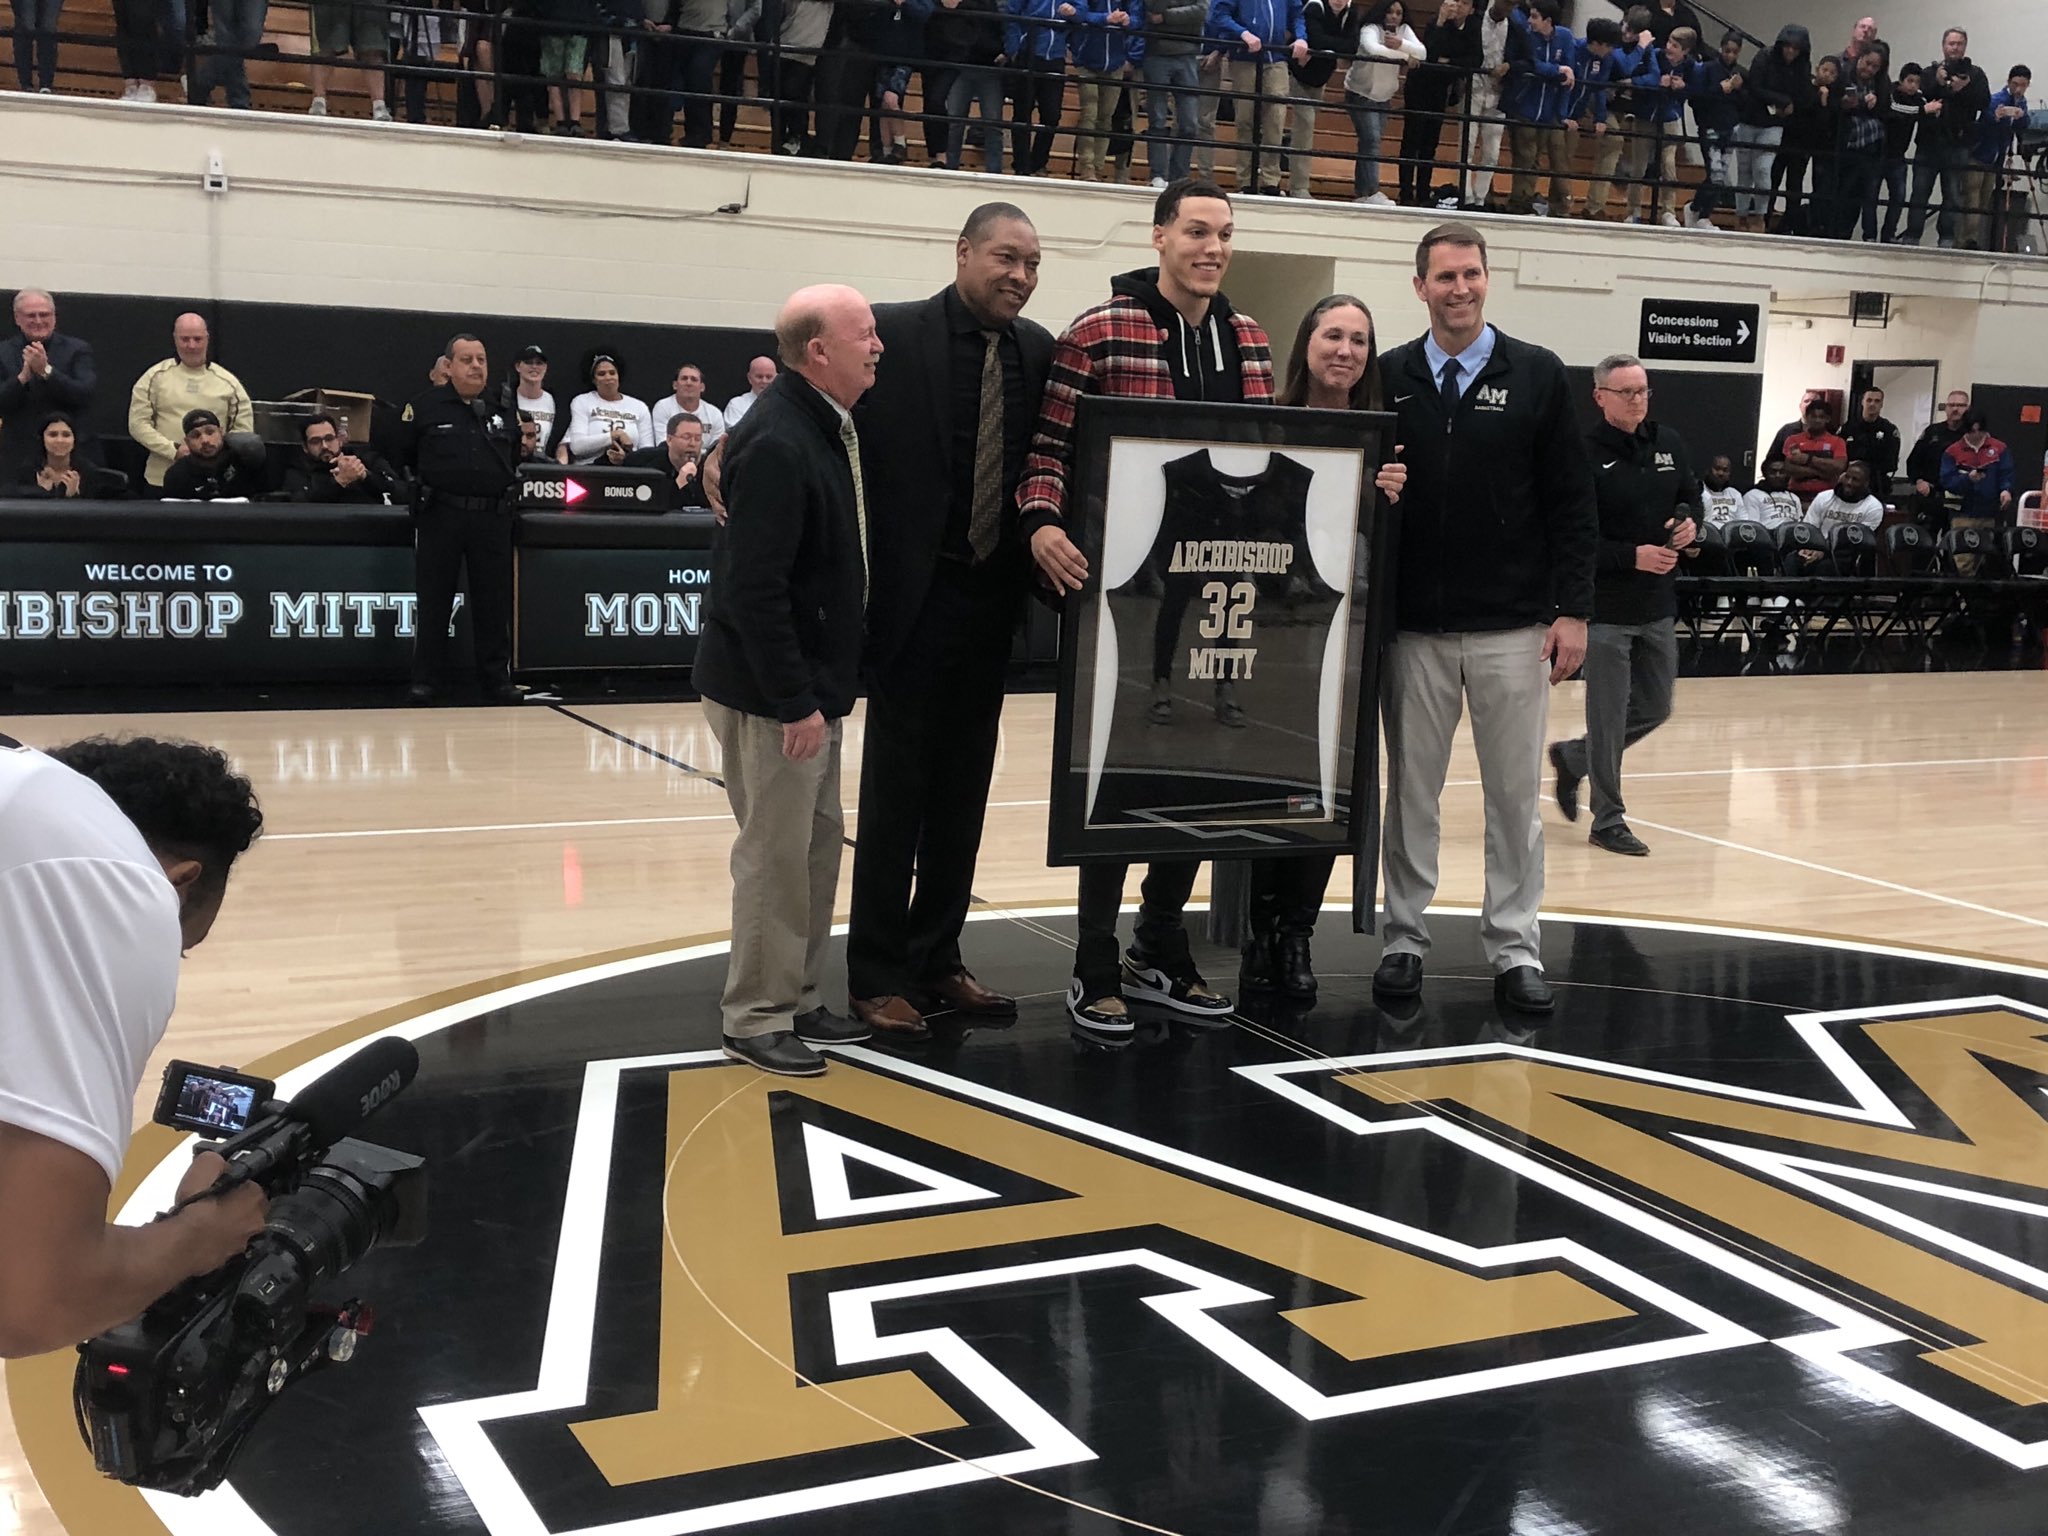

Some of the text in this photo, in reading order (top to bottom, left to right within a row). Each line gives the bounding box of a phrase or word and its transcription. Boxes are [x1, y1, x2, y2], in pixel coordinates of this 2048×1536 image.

[1648, 313, 1719, 328] Concessions
[1648, 332, 1732, 347] Visitor's Section
[1476, 384, 1509, 405] AM
[523, 481, 565, 498] POSS
[604, 486, 634, 497] BONUS
[1168, 540, 1294, 574] ARCHBISHOP
[85, 564, 233, 581] WELCOME TO
[669, 569, 711, 584] HOM
[585, 593, 705, 636] MON
[1199, 581, 1256, 639] 32
[1188, 648, 1257, 680] MITTY
